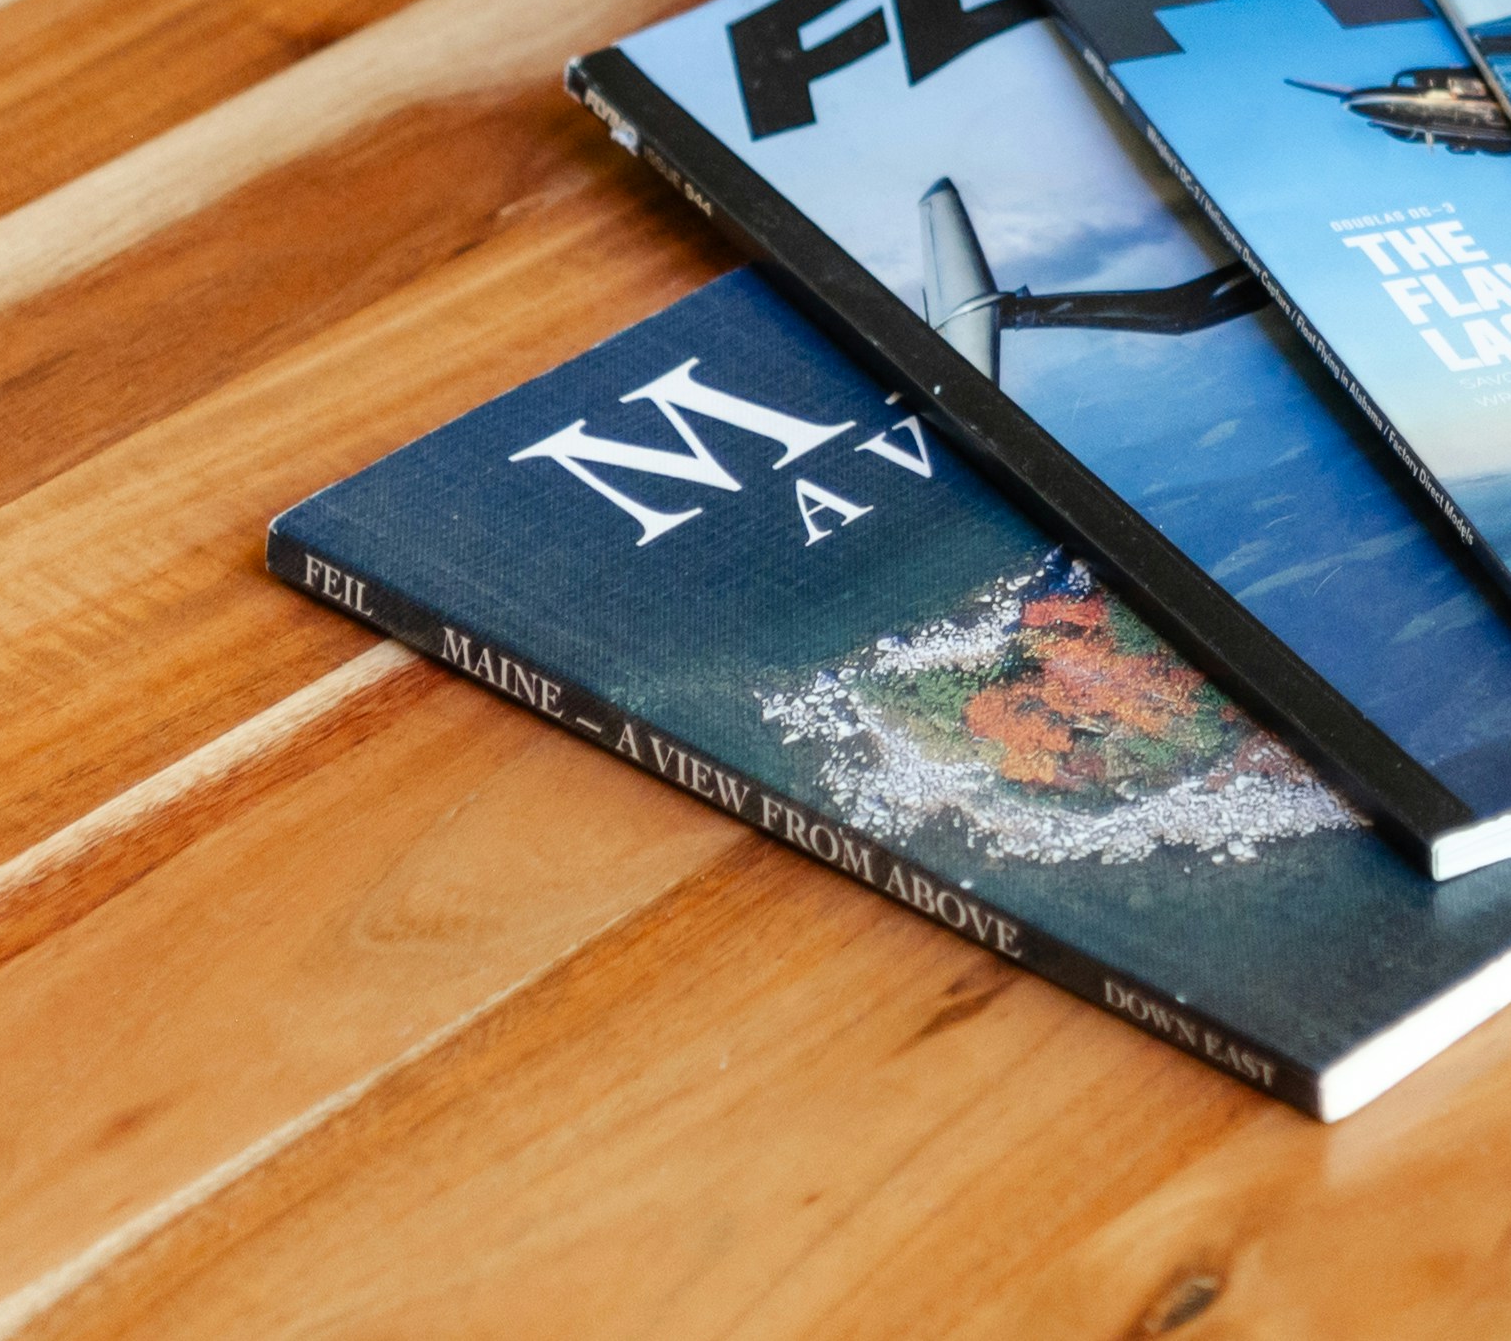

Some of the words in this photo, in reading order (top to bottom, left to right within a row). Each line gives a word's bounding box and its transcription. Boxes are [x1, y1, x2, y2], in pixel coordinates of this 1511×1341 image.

[684, 182, 713, 218] 944
[1328, 208, 1406, 233] DOUGLAS
[1341, 219, 1490, 276] THE
[508, 356, 902, 548] M
[1260, 270, 1292, 317] Capture
[1296, 314, 1318, 349] Float
[1316, 338, 1341, 380] Flying
[1339, 367, 1350, 389] in
[1348, 381, 1384, 436] Alabama
[1388, 432, 1419, 477] Factory
[1418, 468, 1445, 512] Direct
[1443, 499, 1475, 547] Models
[303, 553, 375, 617] FEIL
[441, 626, 564, 720] MAINE
[615, 722, 647, 759] A
[648, 740, 751, 815] VIEW
[761, 796, 877, 884] FROM
[884, 863, 1023, 961] ABOVE
[1103, 977, 1195, 1048] DOWN
[1204, 1027, 1278, 1090] EAST
